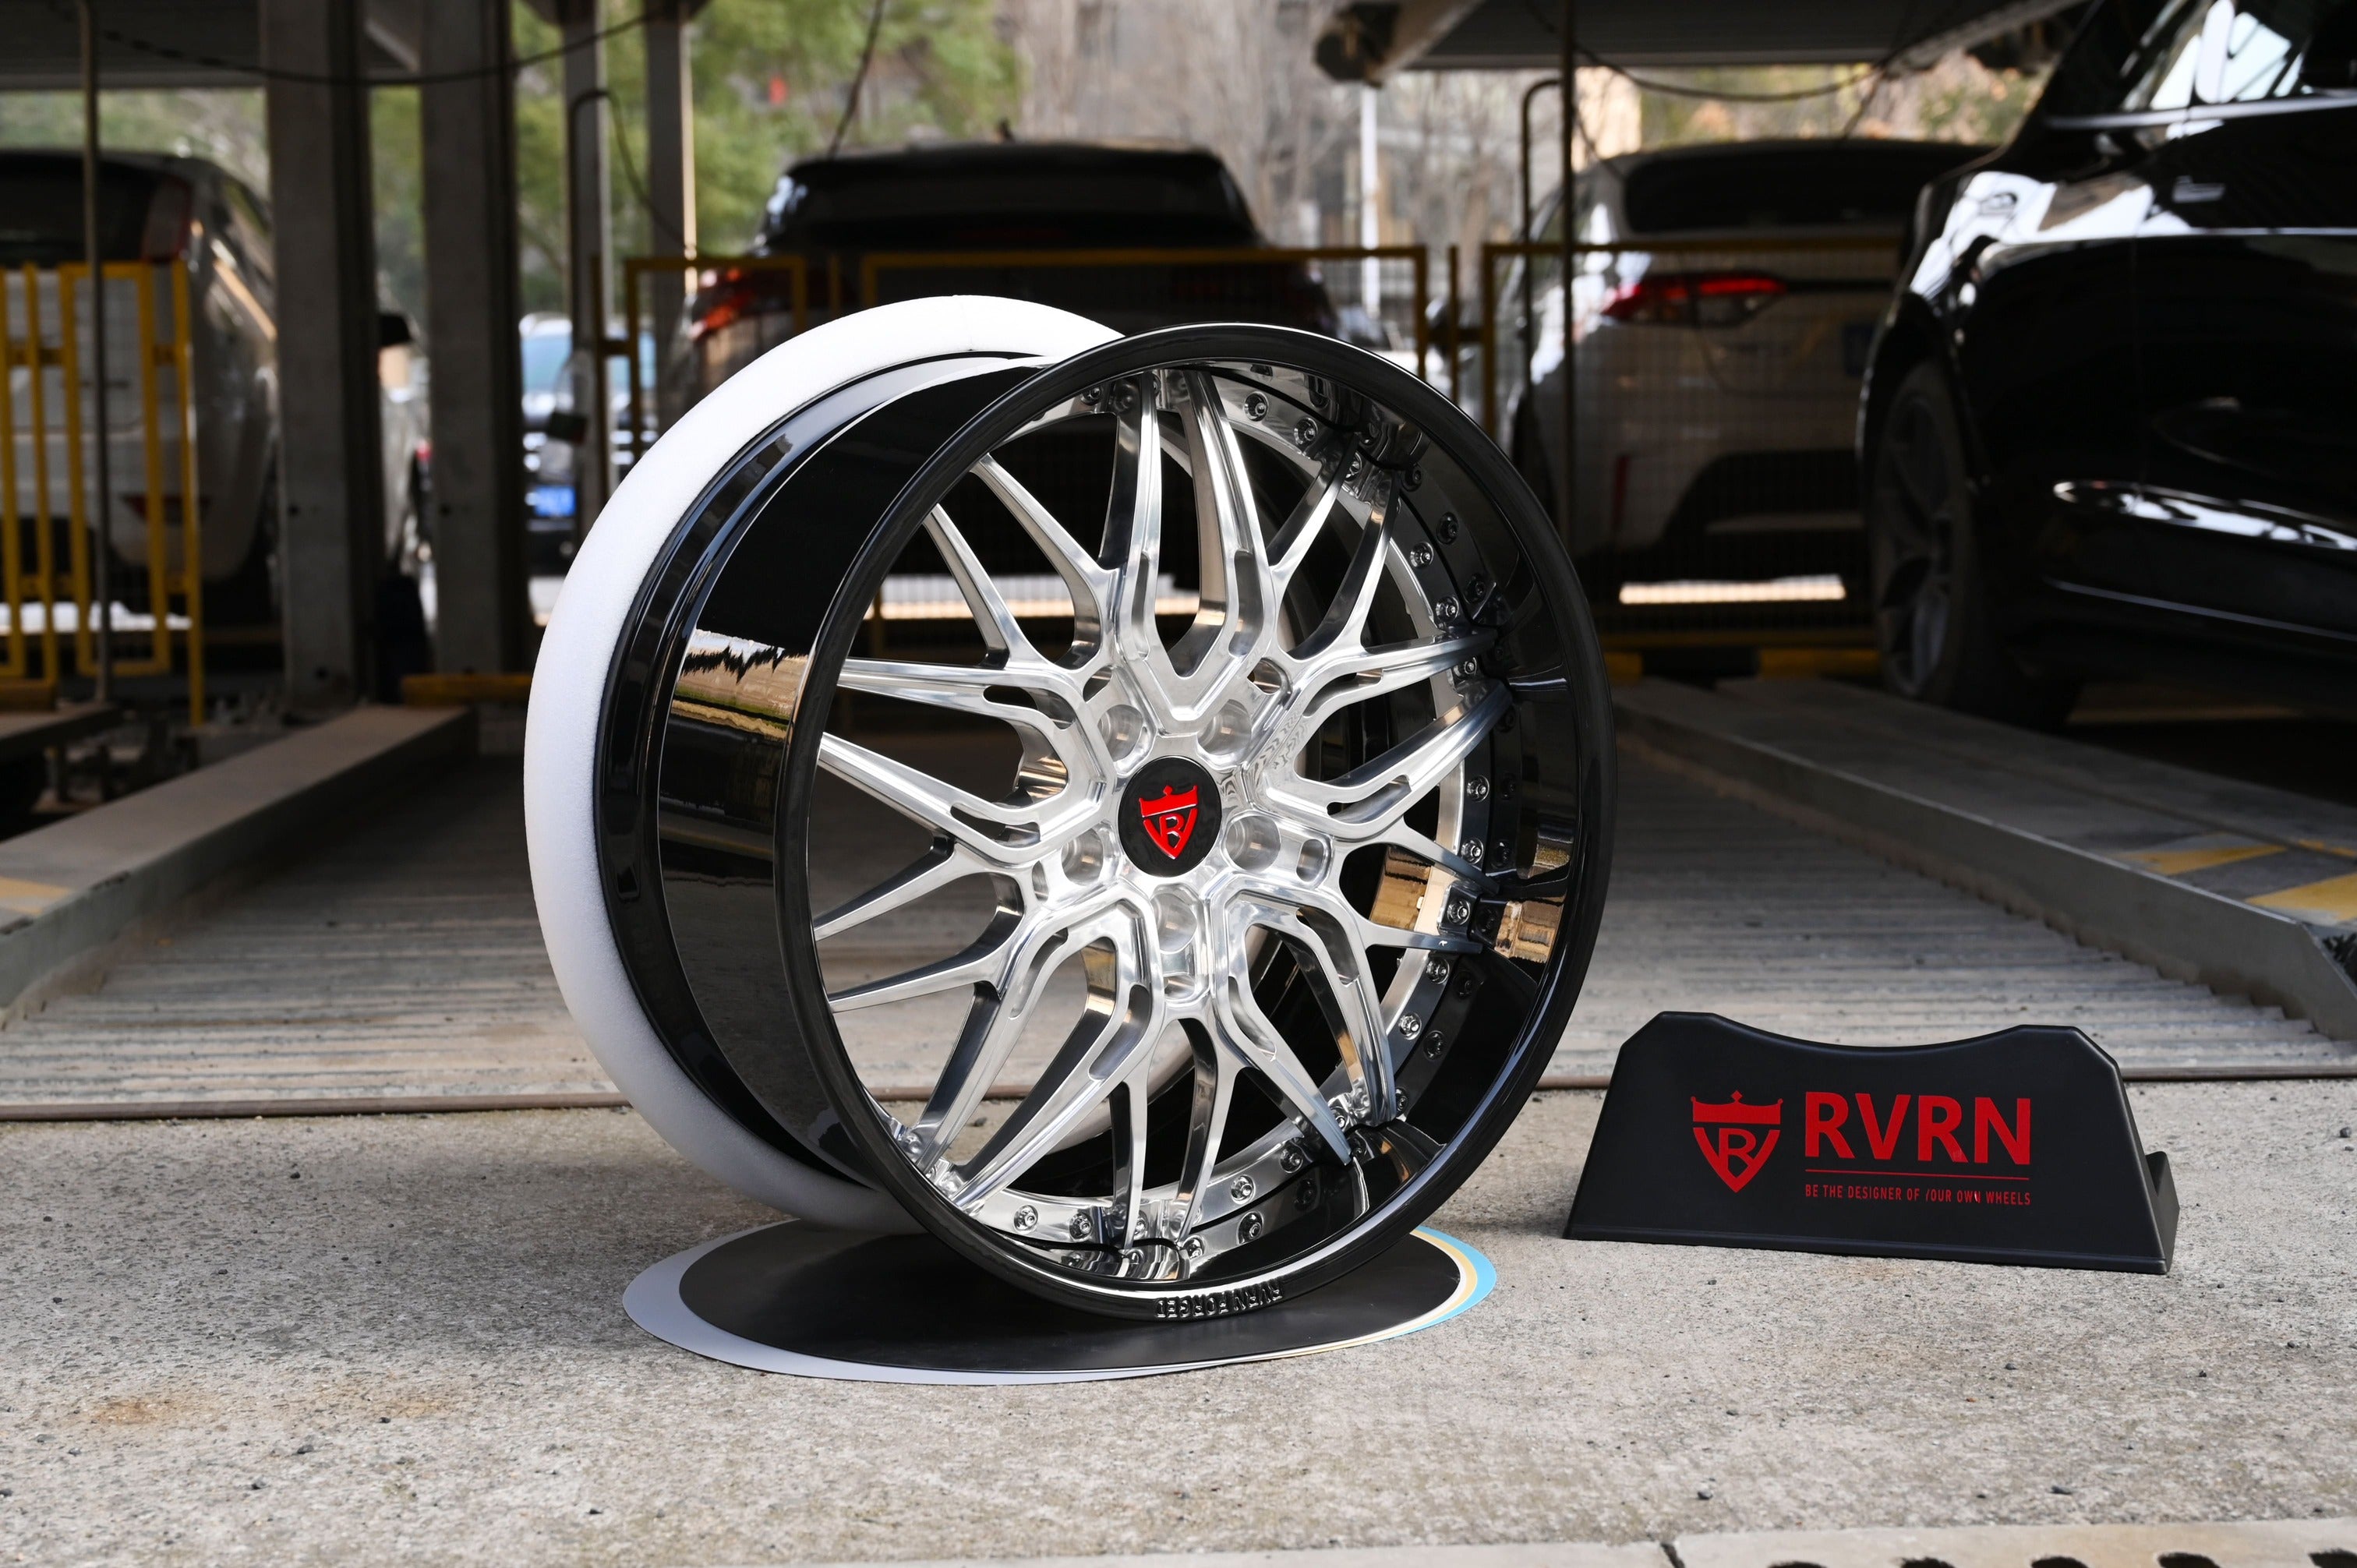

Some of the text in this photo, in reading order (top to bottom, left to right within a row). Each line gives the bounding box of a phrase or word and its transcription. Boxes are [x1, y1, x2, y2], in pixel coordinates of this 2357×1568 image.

[1804, 1091, 2031, 1165] RVRN
[1805, 1184, 1819, 1198] BE
[1823, 1185, 1843, 1199] THE
[1848, 1185, 1902, 1200] DESIGNER
[1906, 1188, 1920, 1201] OF
[1956, 1189, 1981, 1203] OWN
[1986, 1191, 2031, 1206] WHEELS
[1155, 1292, 1229, 1318] FORGED
